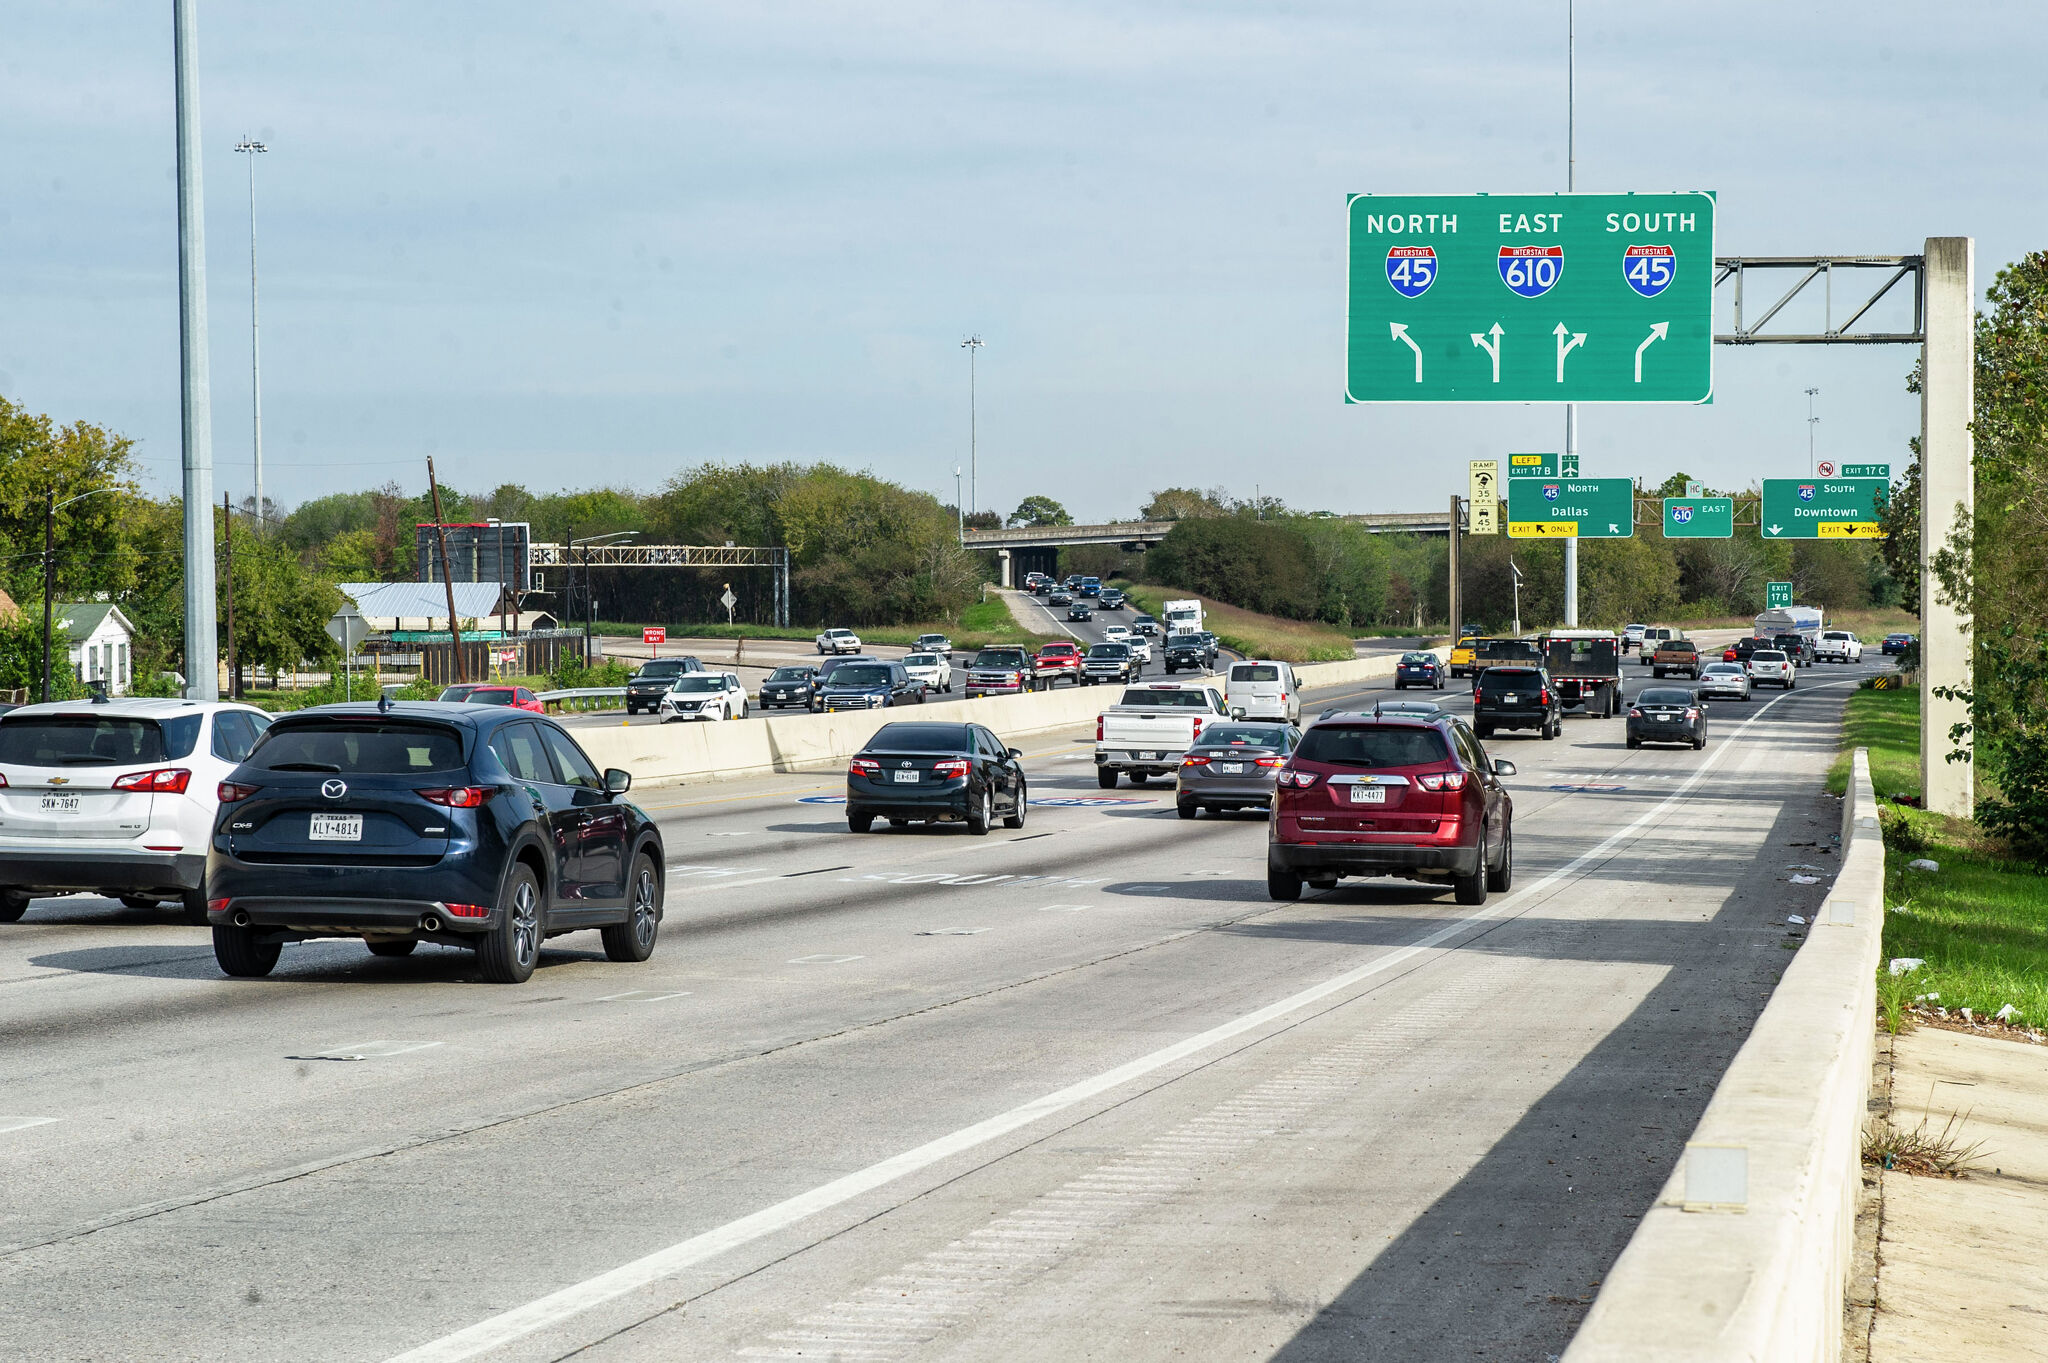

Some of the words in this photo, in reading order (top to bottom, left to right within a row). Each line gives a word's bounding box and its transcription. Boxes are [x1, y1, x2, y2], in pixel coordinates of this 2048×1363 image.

[1367, 214, 1458, 234] NORTH
[1499, 213, 1563, 233] EAST
[1606, 212, 1695, 232] SOUTH
[1393, 249, 1430, 257] INTERSTATE
[1512, 248, 1549, 256] INTERSTATE
[1631, 247, 1668, 256] INTERSTATE
[1391, 258, 1433, 287] 45
[1506, 258, 1556, 287] 610
[1629, 257, 1671, 286] 45
[1531, 467, 1543, 475] 17
[1544, 467, 1551, 475] B
[1865, 467, 1876, 475] 17
[1878, 467, 1885, 475] C
[1545, 489, 1558, 498] 45
[1567, 484, 1599, 493] NORTH
[1689, 484, 1700, 493] HC
[1800, 489, 1814, 499] 45
[1823, 484, 1855, 493] SOUTH
[1551, 506, 1589, 516] Dallas
[1673, 510, 1692, 521] 610
[1702, 505, 1726, 513] EAST
[1794, 507, 1858, 517] Downtown
[1771, 593, 1780, 601] 17
[1782, 593, 1789, 601] B
[838, 871, 1112, 889] SOUTH
